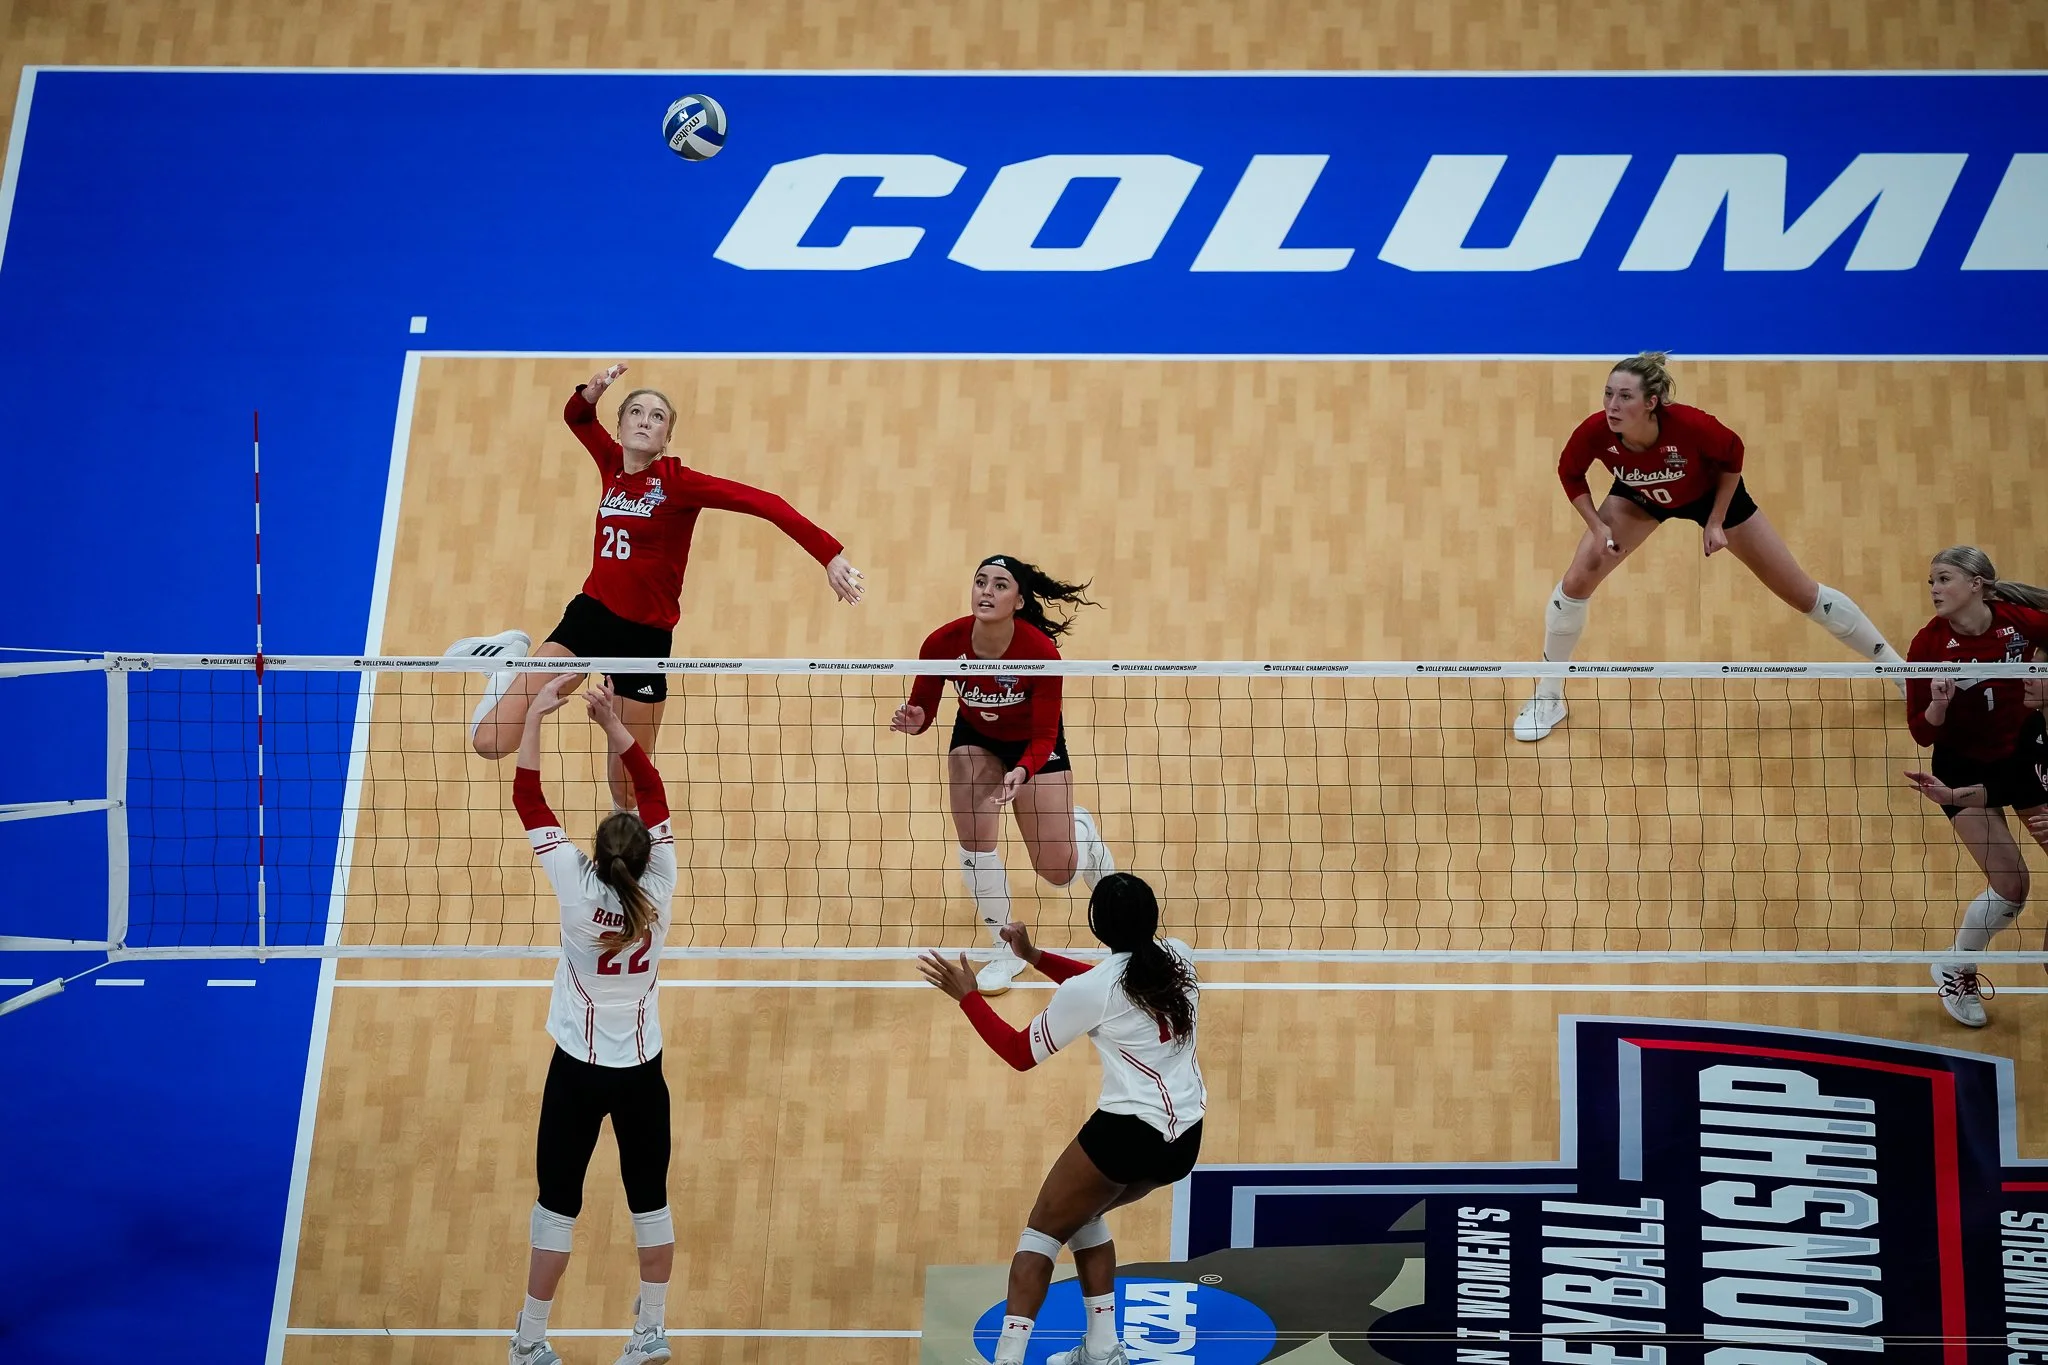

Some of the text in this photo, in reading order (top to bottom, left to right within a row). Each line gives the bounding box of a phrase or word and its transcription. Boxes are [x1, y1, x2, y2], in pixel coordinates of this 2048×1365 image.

[672, 116, 701, 146] molten
[1612, 465, 1686, 482] Nebraska
[600, 486, 655, 514] Nebraska
[1640, 488, 1673, 504] 10
[600, 525, 631, 560] 26
[954, 680, 1025, 703] Nebraska
[1983, 687, 1995, 711] 1
[597, 930, 653, 975] 22
[1457, 1206, 1511, 1319] WOMEN'S
